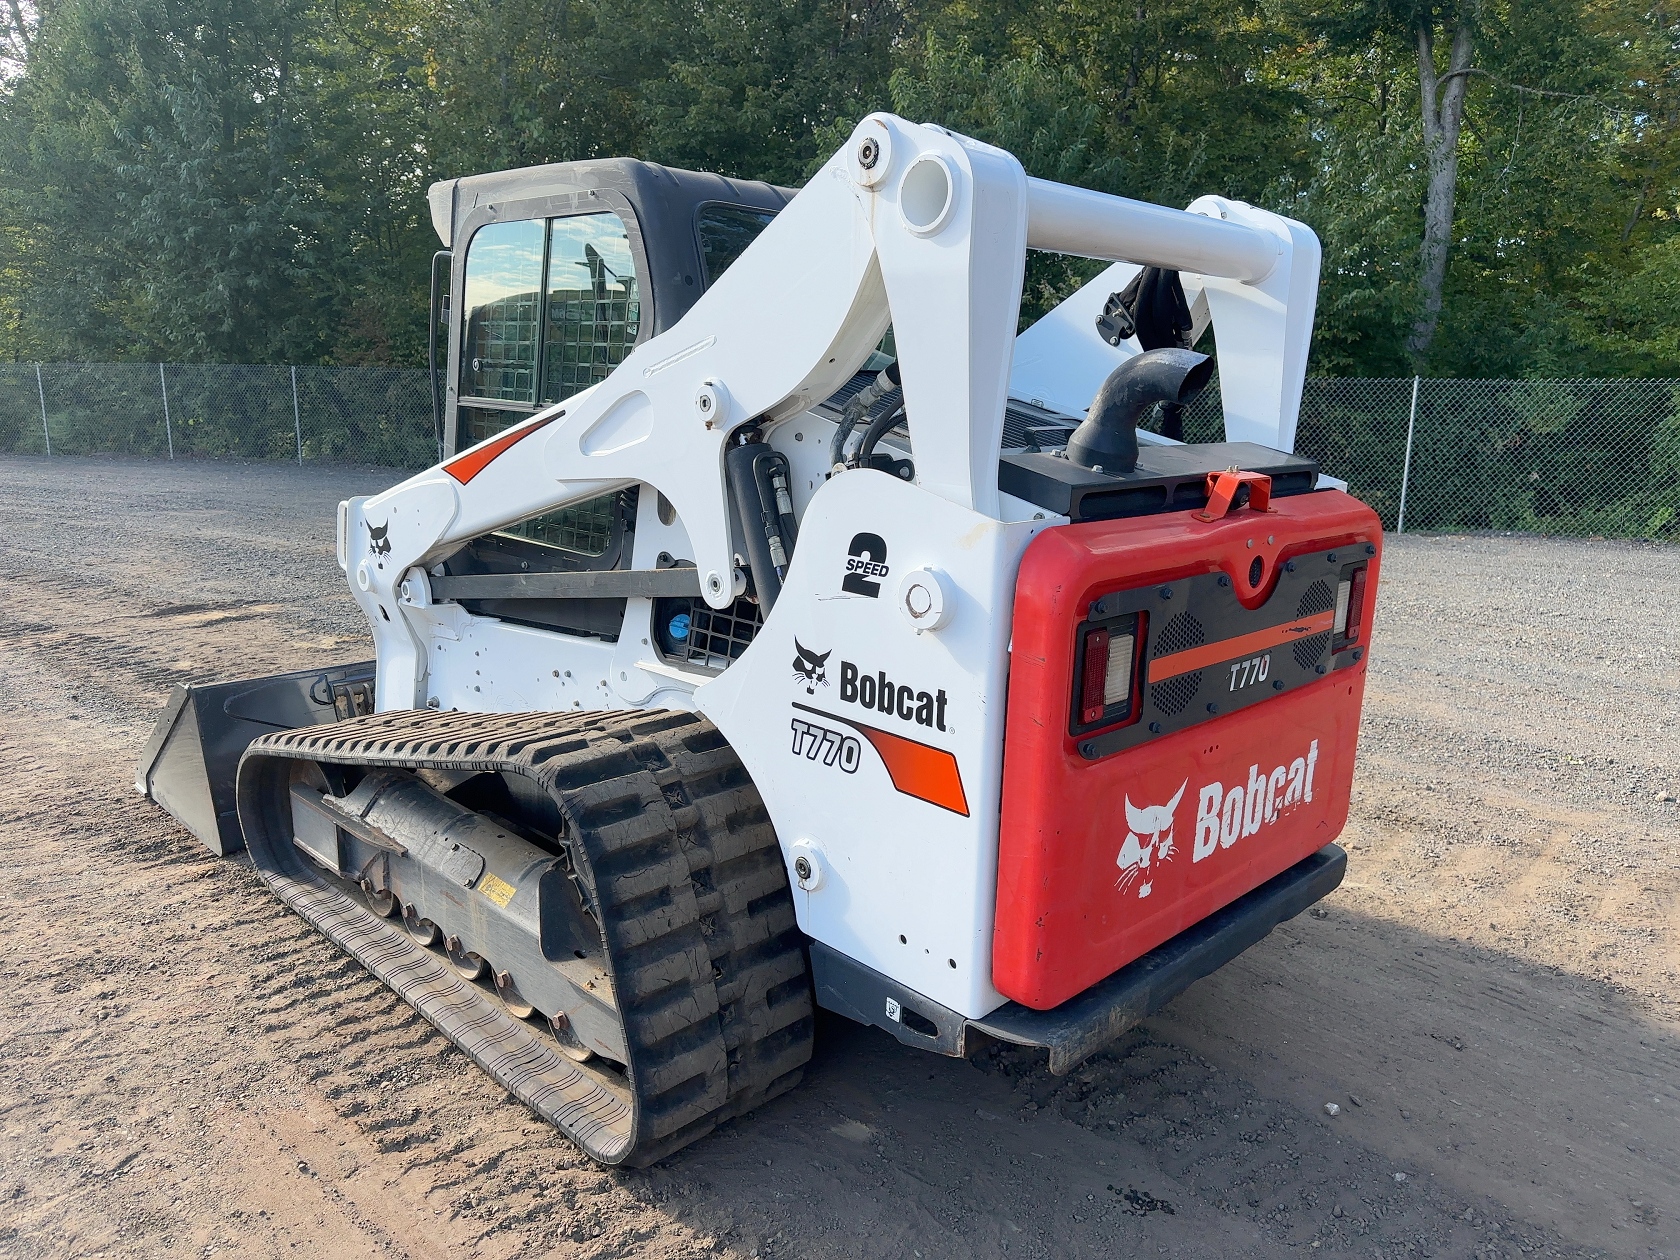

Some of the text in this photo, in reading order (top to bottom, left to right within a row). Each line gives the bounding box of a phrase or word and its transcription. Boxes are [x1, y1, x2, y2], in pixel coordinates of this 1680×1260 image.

[842, 532, 890, 599] 2 SPEED
[840, 660, 948, 733] Bobcat
[1229, 654, 1270, 692] T770
[791, 718, 862, 774] T770
[1193, 739, 1318, 863] Bobcat
